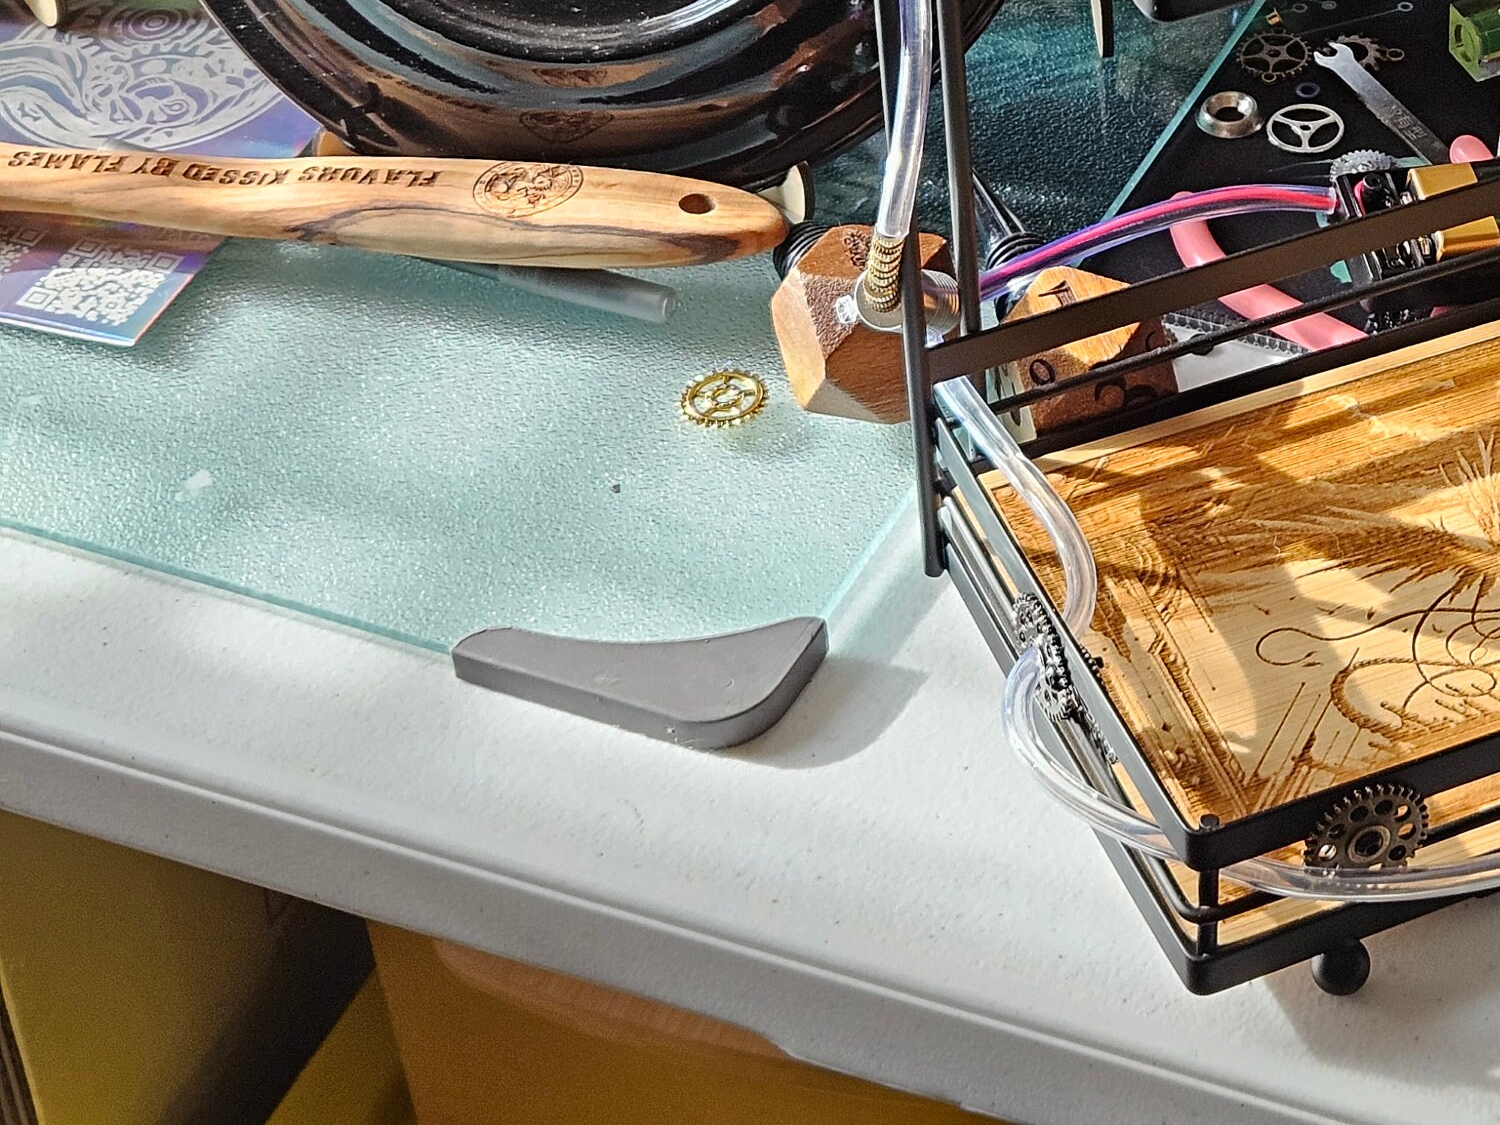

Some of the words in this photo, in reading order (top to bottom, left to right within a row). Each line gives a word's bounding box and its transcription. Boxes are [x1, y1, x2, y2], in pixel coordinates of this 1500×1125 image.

[8, 151, 129, 173] FLAMES
[130, 156, 179, 177] BY
[182, 163, 290, 186] KISSED
